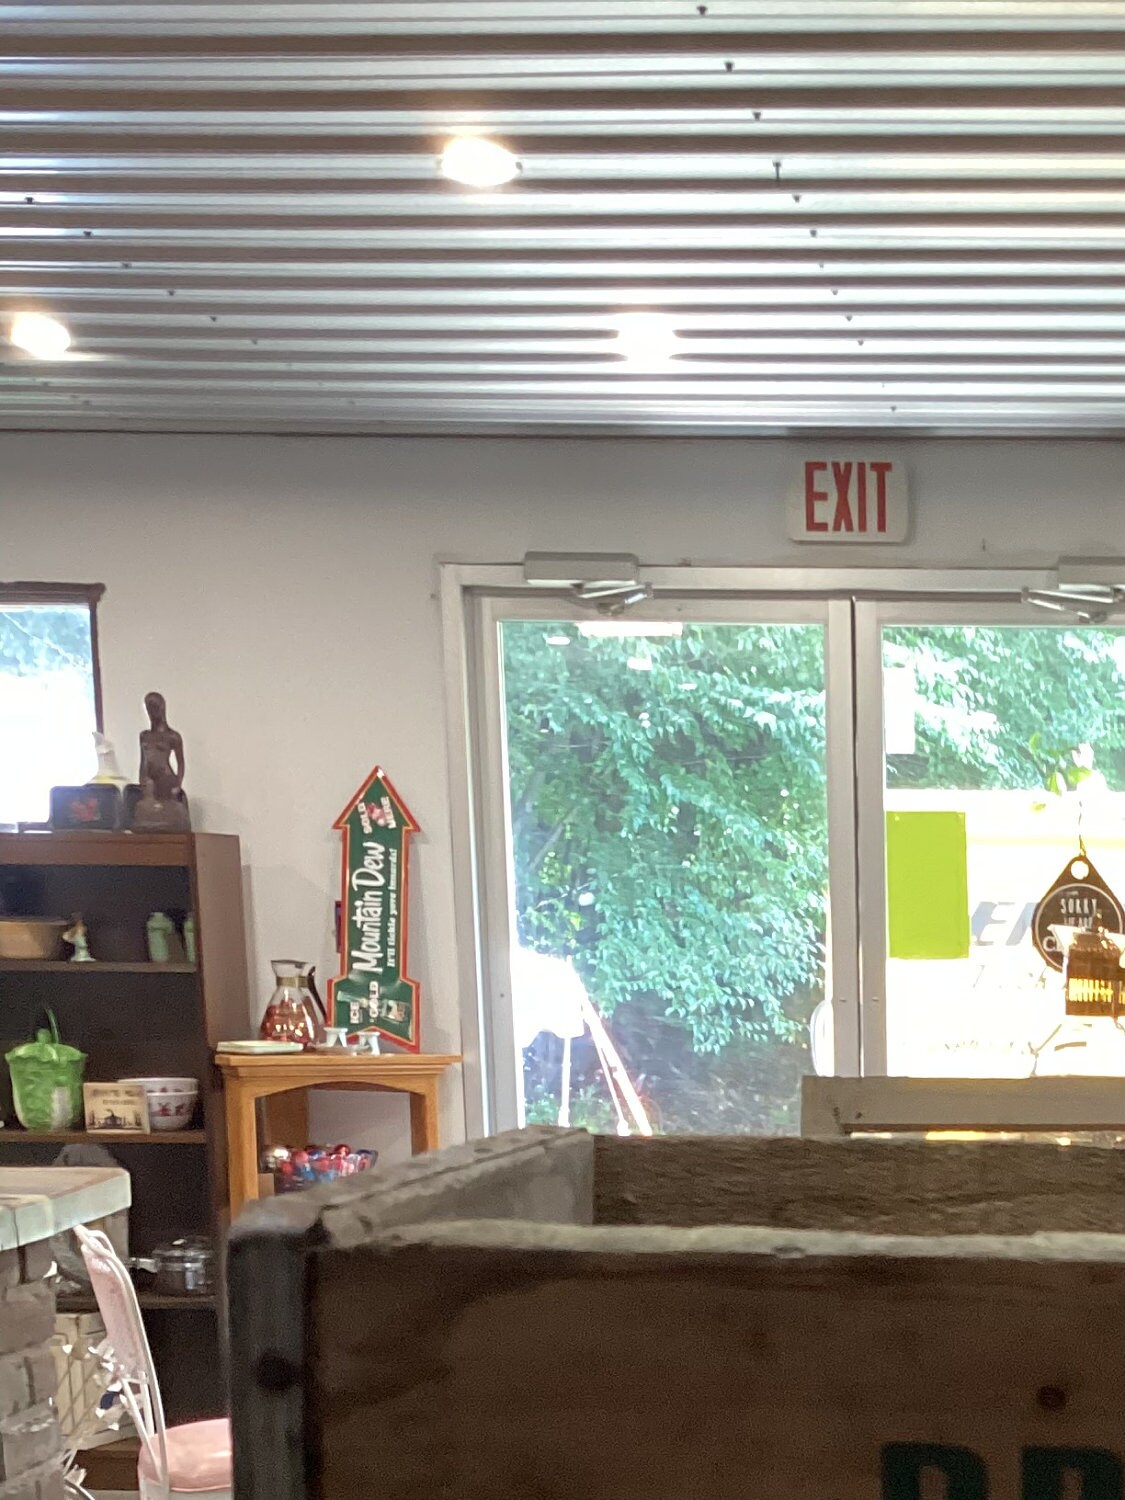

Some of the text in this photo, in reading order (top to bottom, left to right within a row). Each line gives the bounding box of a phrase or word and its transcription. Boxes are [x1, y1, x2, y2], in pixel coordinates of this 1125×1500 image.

[804, 461, 893, 533] EXIT
[358, 801, 373, 834] SOLD
[350, 840, 386, 975] Mountain Dew
[1060, 898, 1097, 918] SORRY
[386, 916, 396, 946] tickle
[350, 1001, 360, 1024] ICE
[369, 980, 379, 1018] COLD
